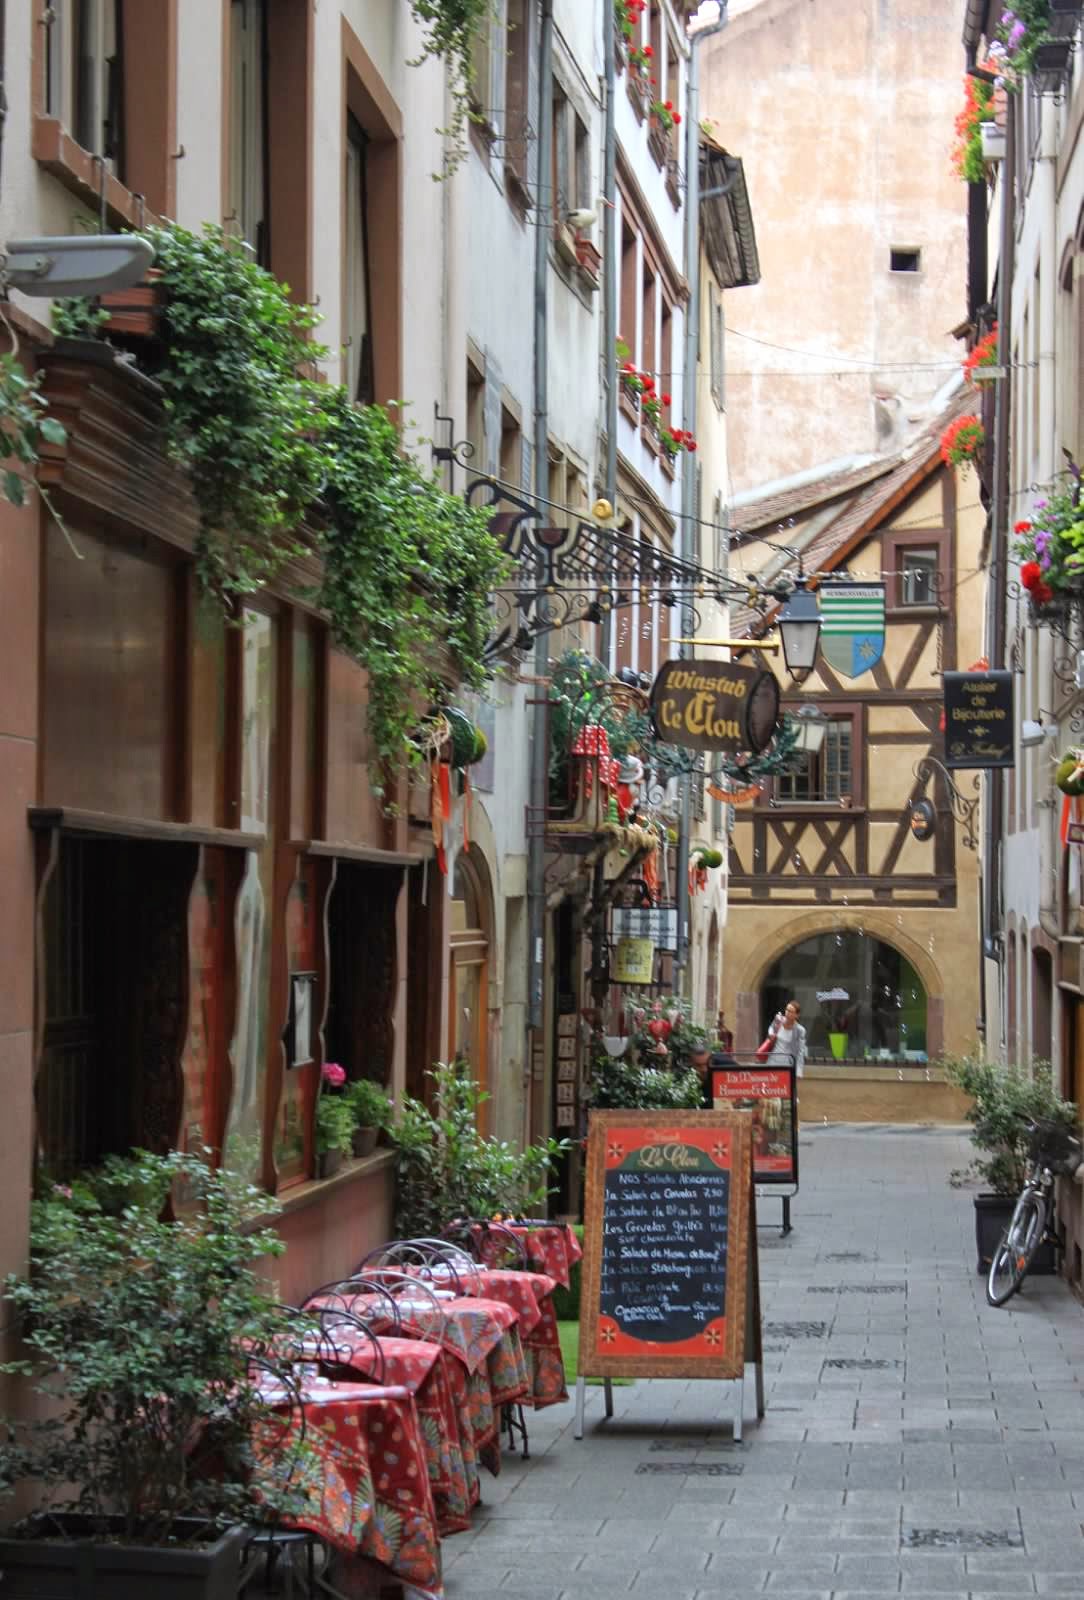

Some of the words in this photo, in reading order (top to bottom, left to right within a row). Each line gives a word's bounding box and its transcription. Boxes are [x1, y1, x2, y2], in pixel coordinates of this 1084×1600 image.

[665, 671, 746, 697] Winstub
[961, 681, 997, 693] Atelier
[971, 695, 986, 706] de
[661, 699, 682, 729] Le
[685, 691, 741, 738] Clou
[952, 707, 1006, 722] Bijouterie
[638, 1145, 664, 1168] Le
[664, 1143, 700, 1169] Clou
[619, 1174, 641, 1185] NOS
